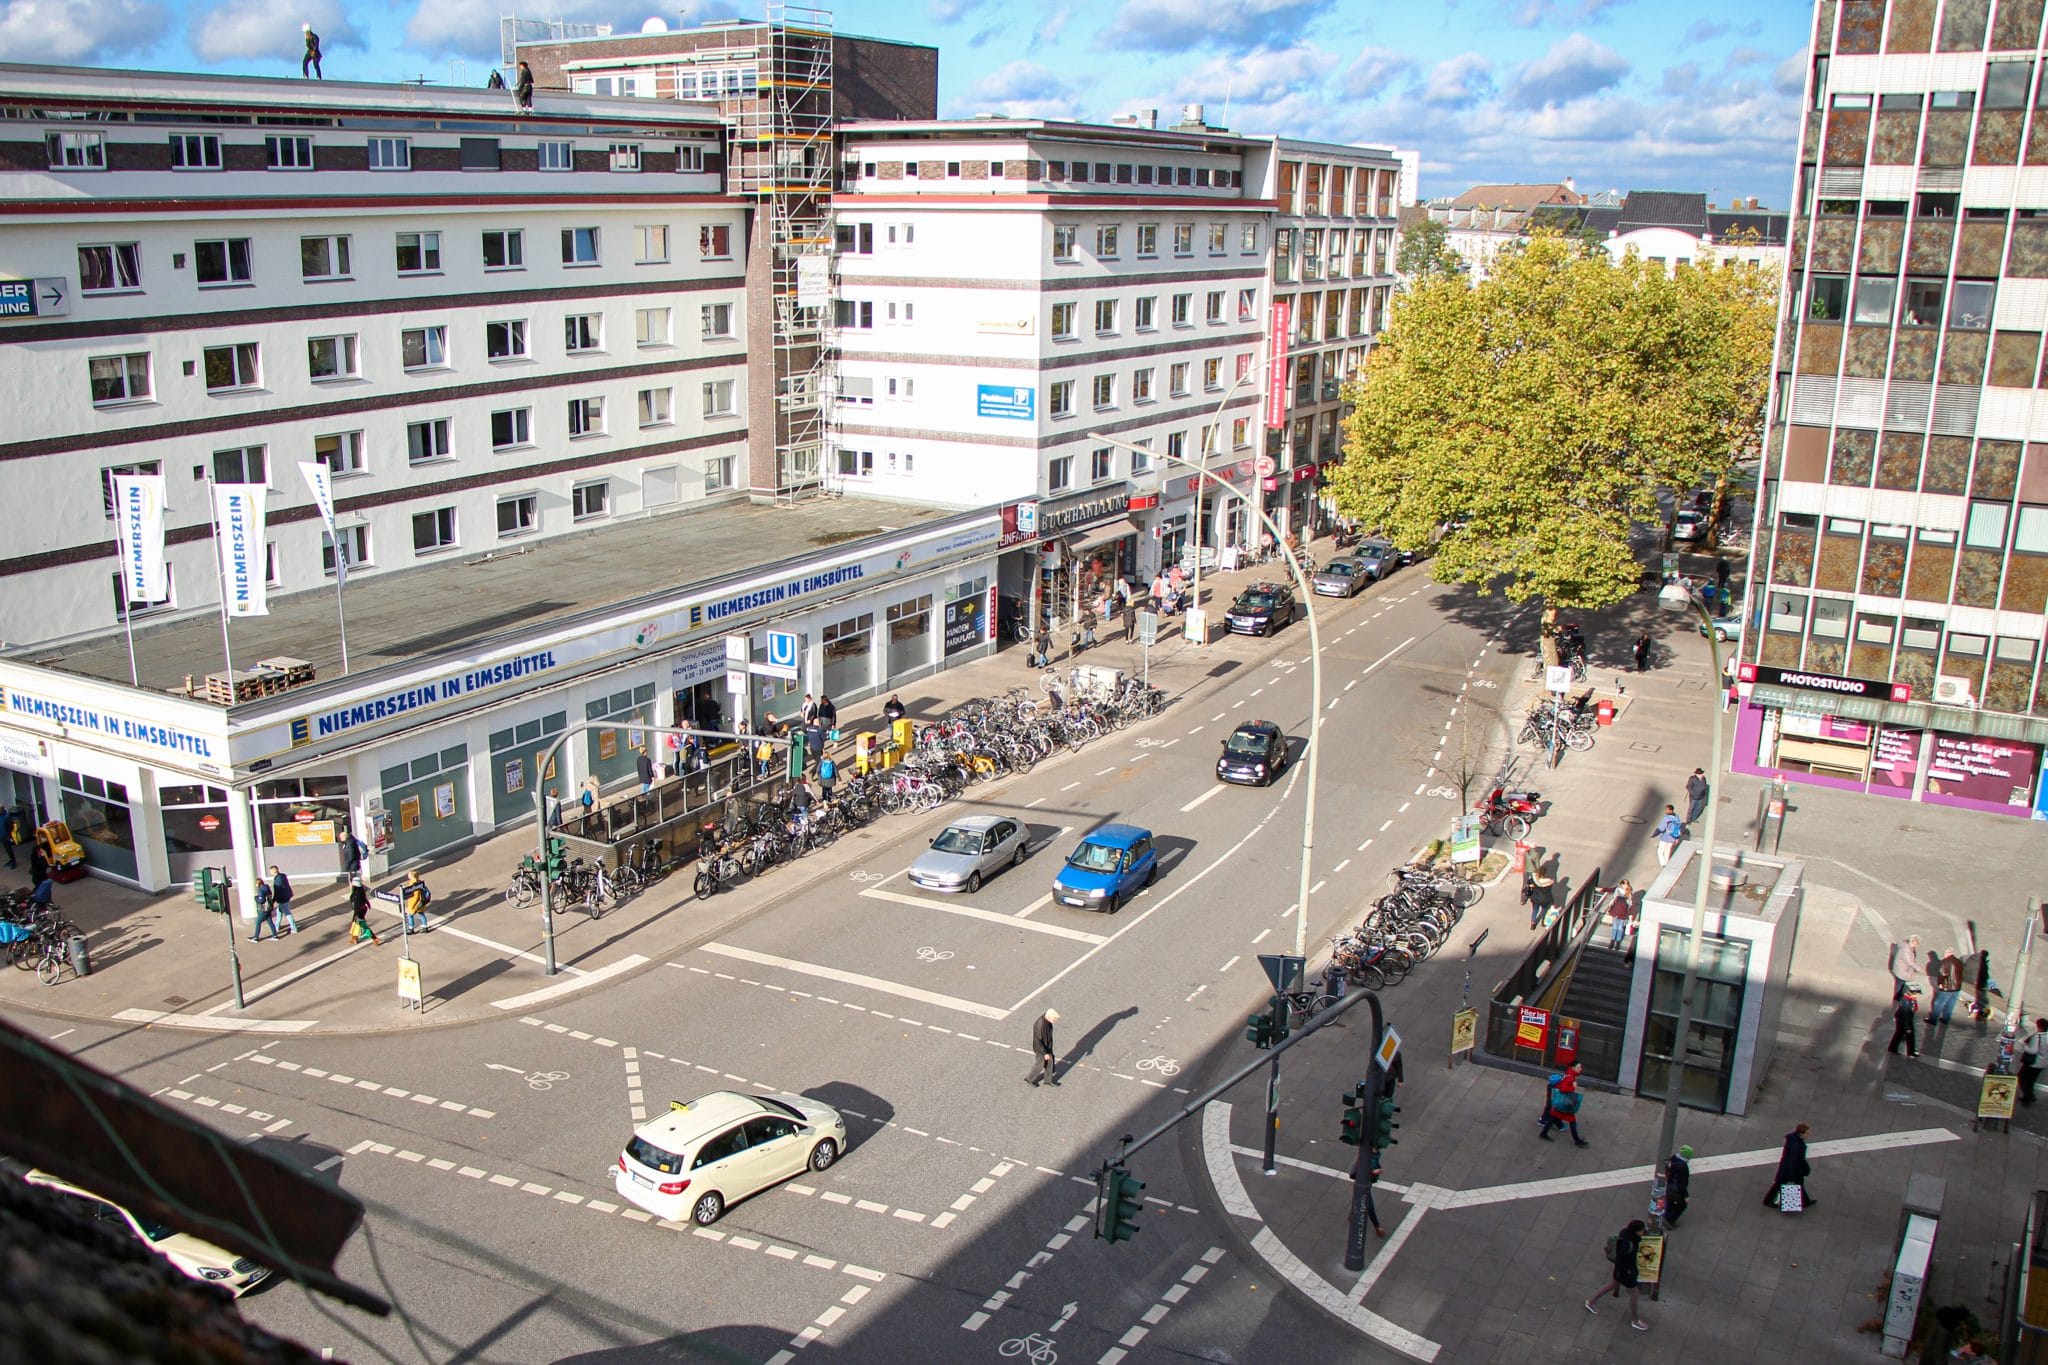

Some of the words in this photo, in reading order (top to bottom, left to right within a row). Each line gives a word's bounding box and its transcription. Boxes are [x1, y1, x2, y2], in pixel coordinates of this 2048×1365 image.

[0, 284, 28, 297] ER
[1042, 493, 1129, 530] BUCHHANDLUNG
[129, 486, 146, 588] NIEMERSZEIN
[229, 495, 249, 600] NIEMERSZEIN
[707, 588, 785, 621] NIEMERSZEIN
[788, 582, 801, 598] IN
[803, 564, 864, 592] EIMSBÜTTEL
[772, 634, 792, 663] U
[318, 684, 436, 736] NIEMERSZEIN
[442, 677, 461, 699] IN
[466, 650, 556, 691] EIMSBÜTTEL
[1780, 672, 1865, 693] PHOTOSTUDIO
[11, 693, 99, 729] NIEMERSZEIN
[104, 715, 120, 735] IN
[124, 720, 211, 757] EIMSBÜTTEL
[1939, 738, 1955, 749] Um
[1956, 741, 1970, 751] die
[1971, 743, 1993, 754] Ecke
[1947, 750, 1961, 760] ein
[1521, 1007, 1537, 1018] Hier
